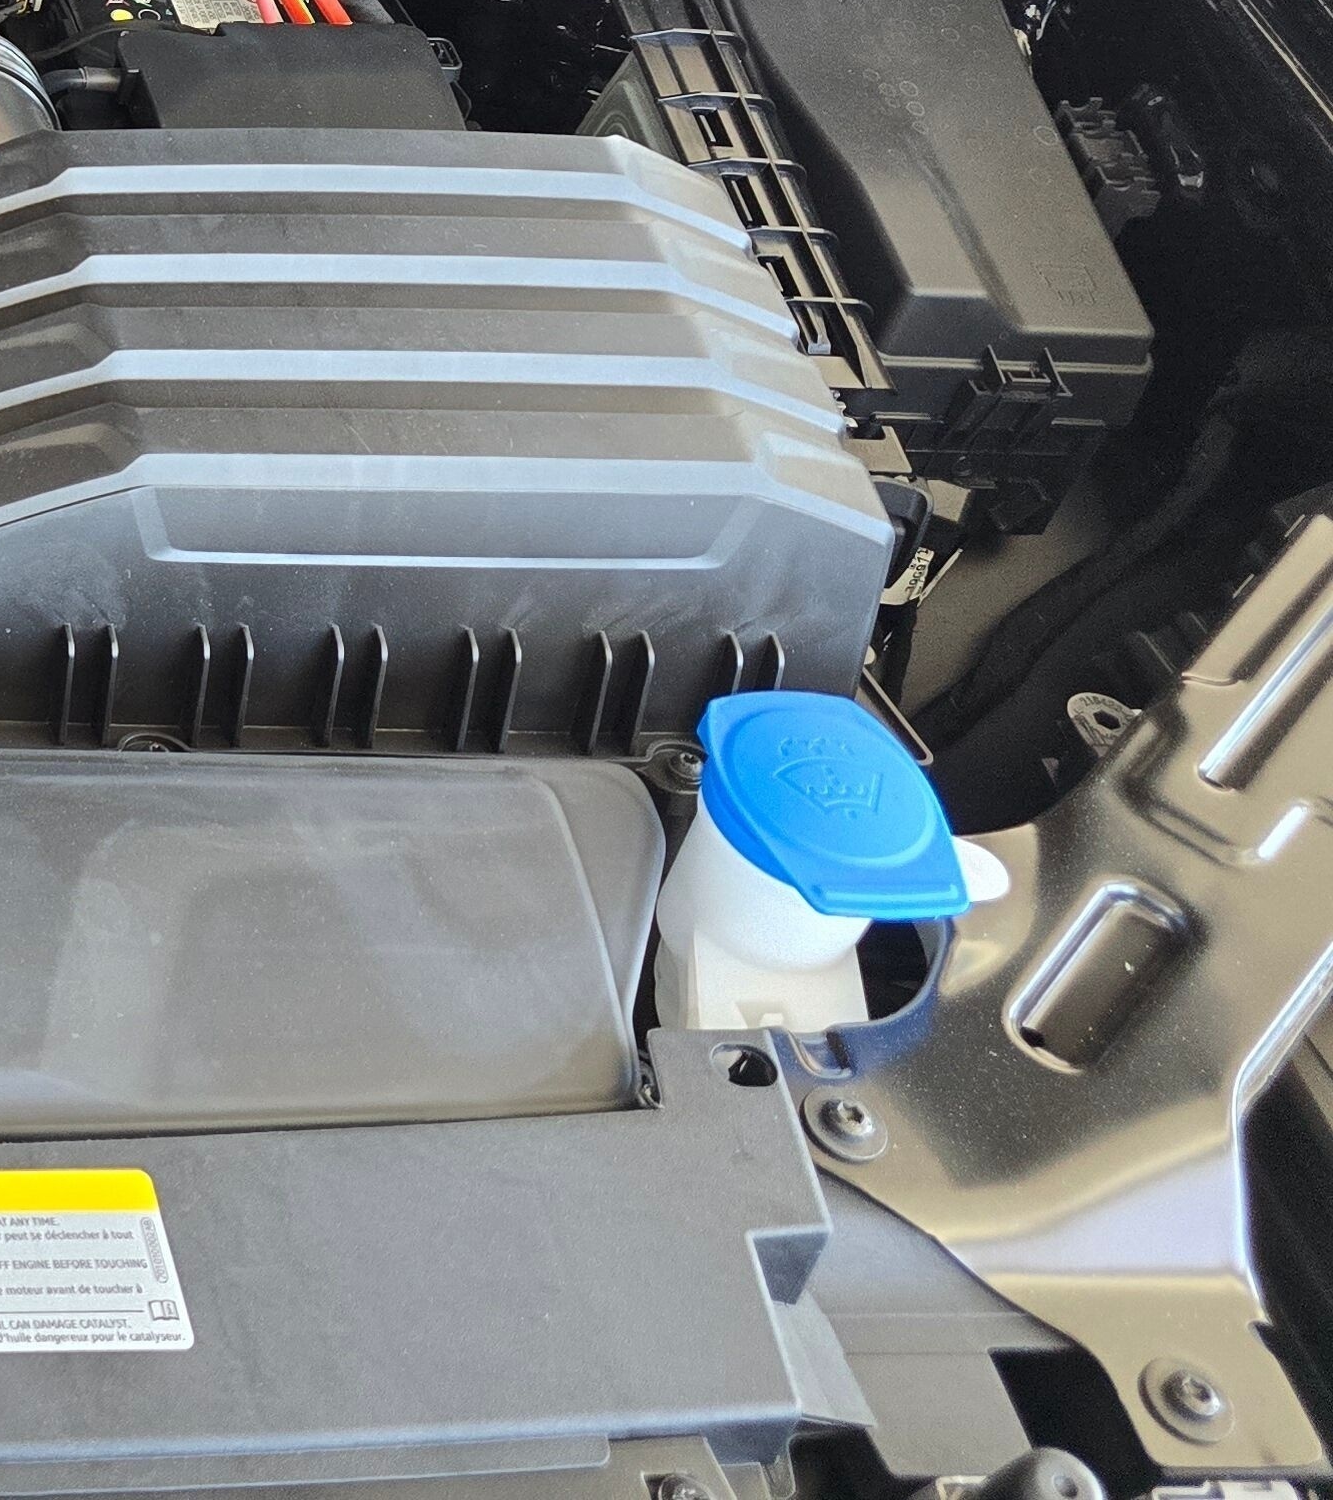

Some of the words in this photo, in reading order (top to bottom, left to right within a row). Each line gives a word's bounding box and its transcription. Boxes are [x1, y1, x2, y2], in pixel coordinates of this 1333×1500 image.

[9, 1217, 31, 1227] ANY
[4, 1231, 30, 1242] peut
[111, 1230, 134, 1240] tout
[13, 1259, 50, 1270] ENGINE
[53, 1258, 92, 1269] BEFORE
[94, 1258, 148, 1269] TOUCHING
[6, 1285, 44, 1296] moteur
[47, 1285, 75, 1295] avant
[78, 1284, 91, 1295] de
[93, 1283, 133, 1295] toucher
[9, 1319, 31, 1330] CAN
[33, 1318, 74, 1330] DAMAGE
[34, 1332, 90, 1344] dangereux
[93, 1334, 114, 1344] pour
[116, 1332, 127, 1341] le
